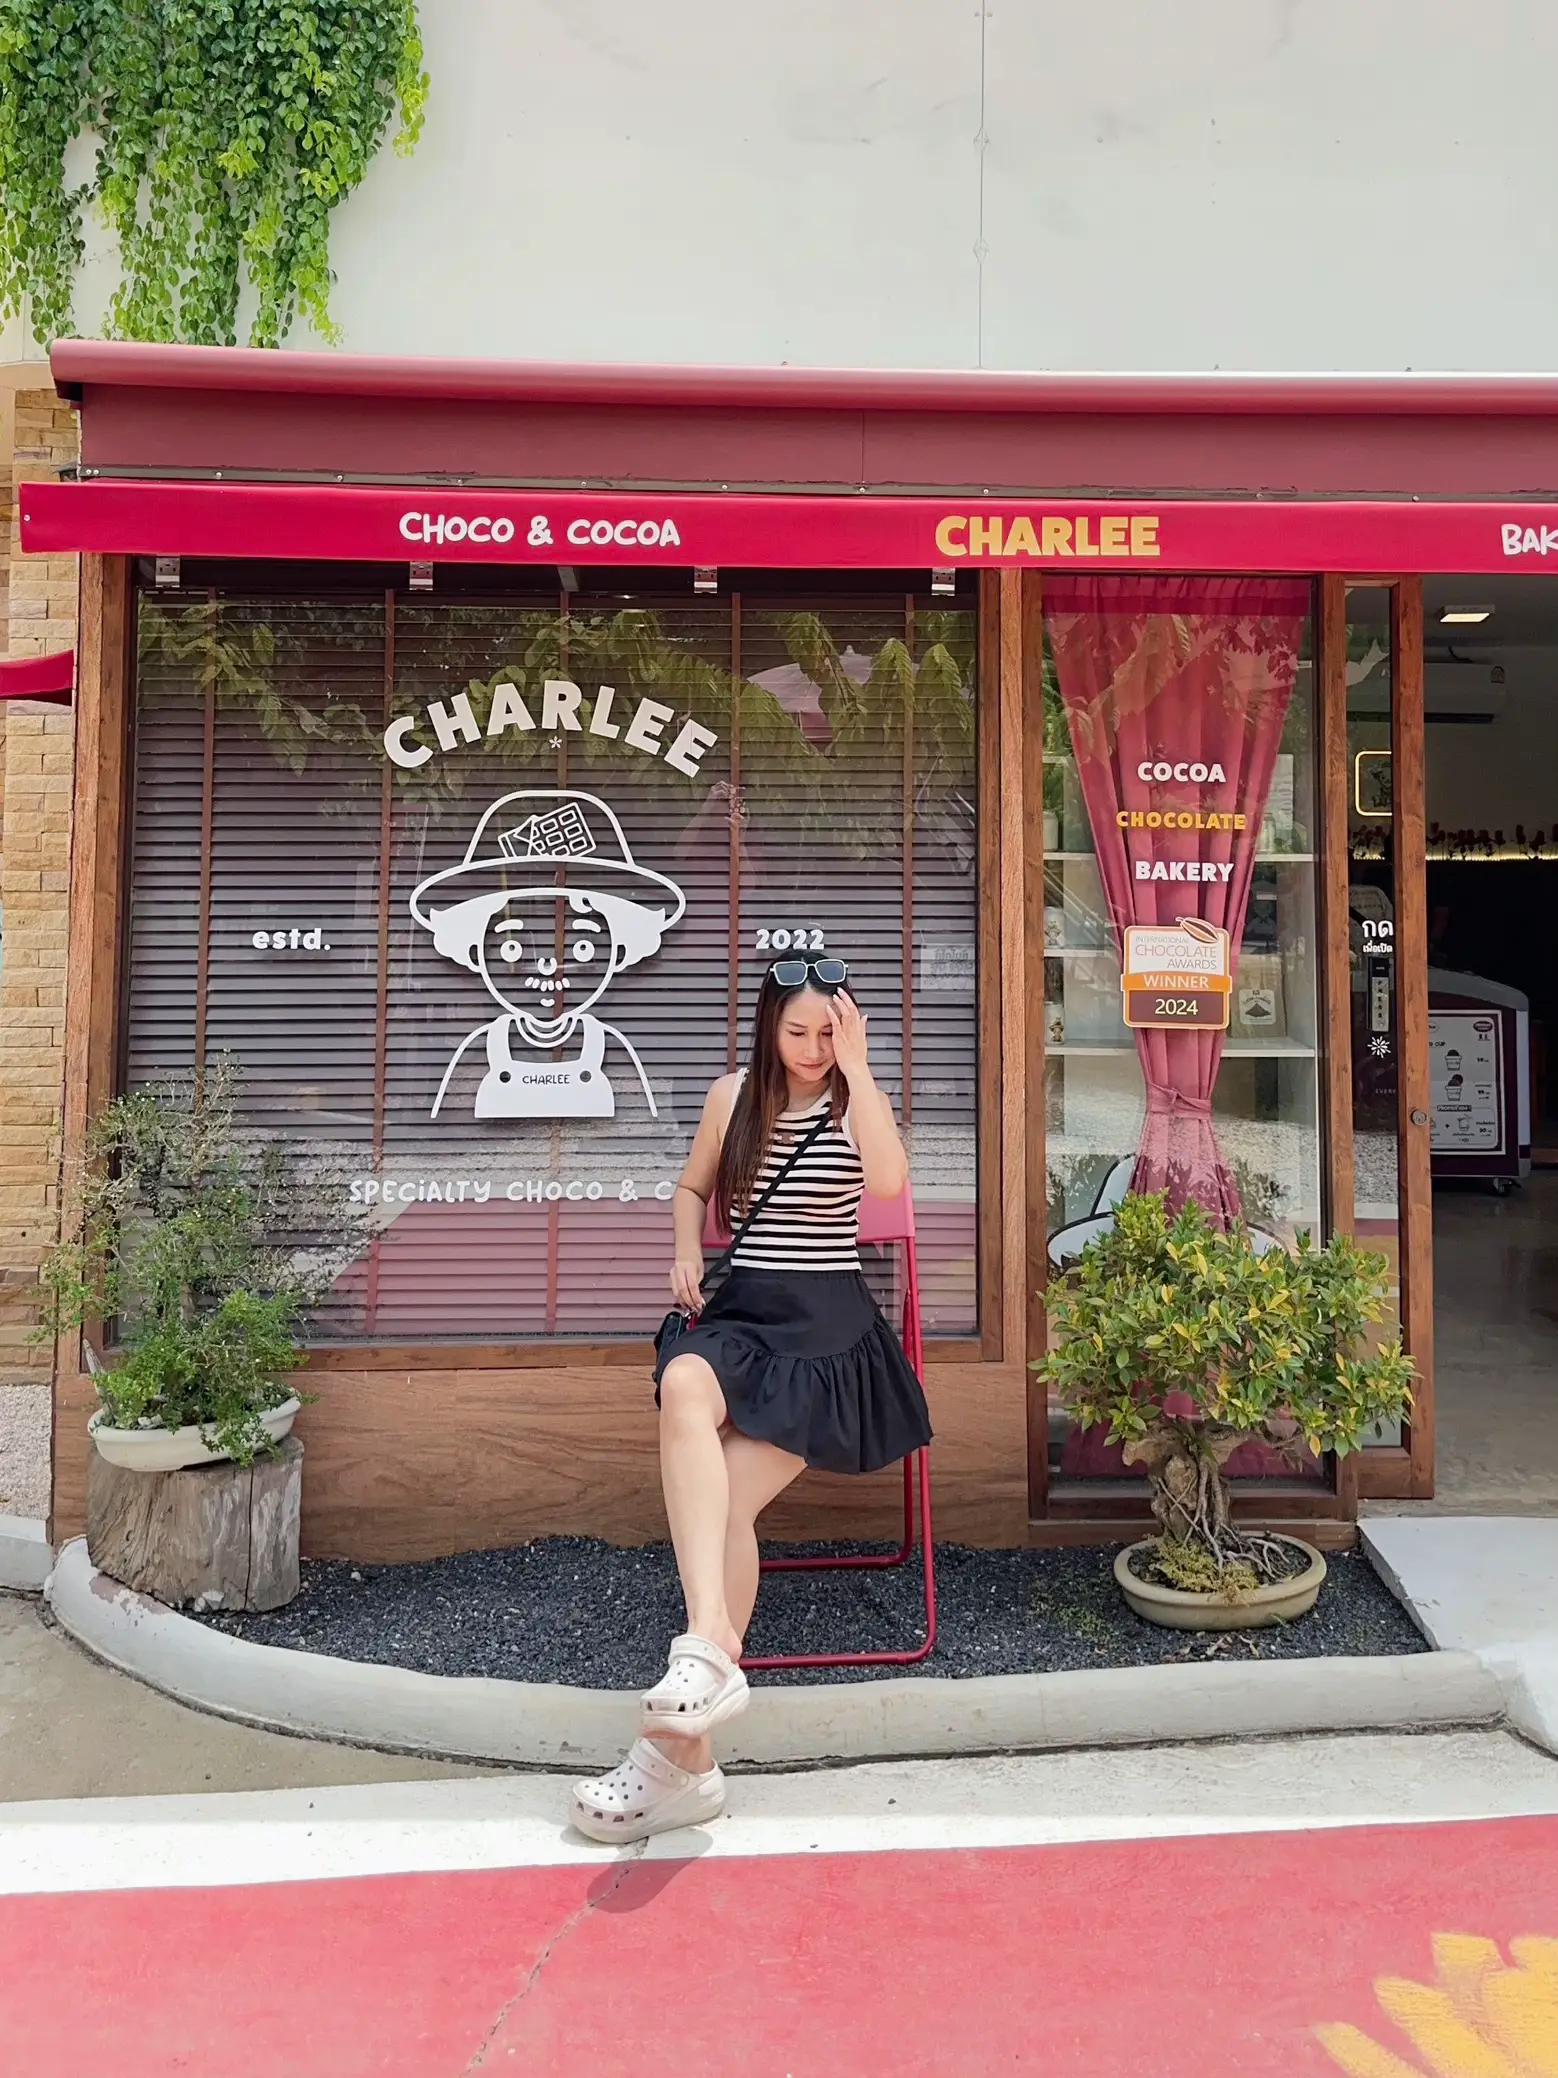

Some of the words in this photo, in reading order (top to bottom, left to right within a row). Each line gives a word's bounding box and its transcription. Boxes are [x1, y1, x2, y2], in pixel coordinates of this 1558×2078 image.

[399, 511, 515, 545] CHOCO
[527, 515, 554, 546] &
[567, 519, 682, 547] COCOA
[935, 515, 1162, 558] CHARLEE
[383, 680, 718, 778] CHARLEE
[1137, 761, 1226, 783] COCOA
[1116, 811, 1247, 830] CHOCOLATE
[1135, 860, 1234, 882] BAKERY
[252, 927, 331, 951] estd.
[755, 928, 825, 950] 2022
[1361, 920, 1394, 938] กด
[1135, 944, 1217, 958] CHOCOLATE
[1167, 958, 1217, 970] AWARDS
[1143, 974, 1209, 989] WINNER
[1154, 998, 1199, 1016] 2024
[522, 1074, 571, 1086] CHARLEE
[506, 1180, 603, 1203] CHOCO
[618, 1179, 638, 1202] &
